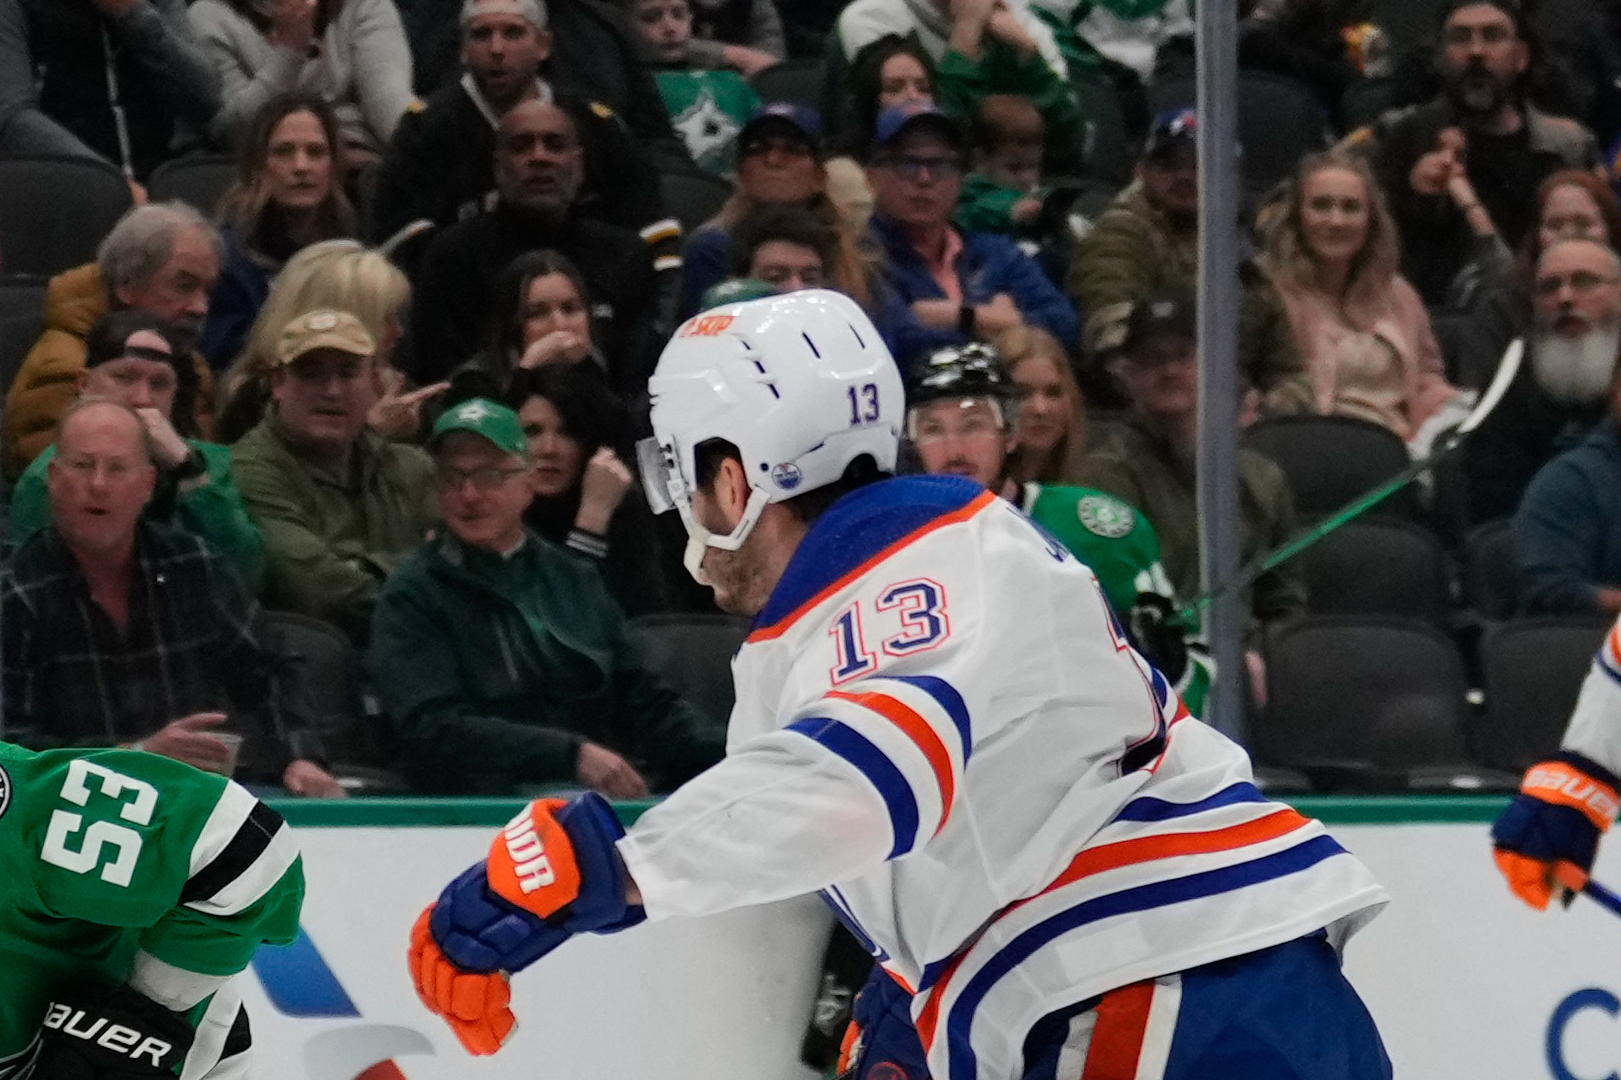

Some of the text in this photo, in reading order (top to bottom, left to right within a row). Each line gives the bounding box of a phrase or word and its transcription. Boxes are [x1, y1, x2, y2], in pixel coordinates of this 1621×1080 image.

[847, 383, 880, 425] 13
[828, 577, 951, 686] 13
[40, 759, 159, 888] 53
[44, 1002, 173, 1068] AUER
